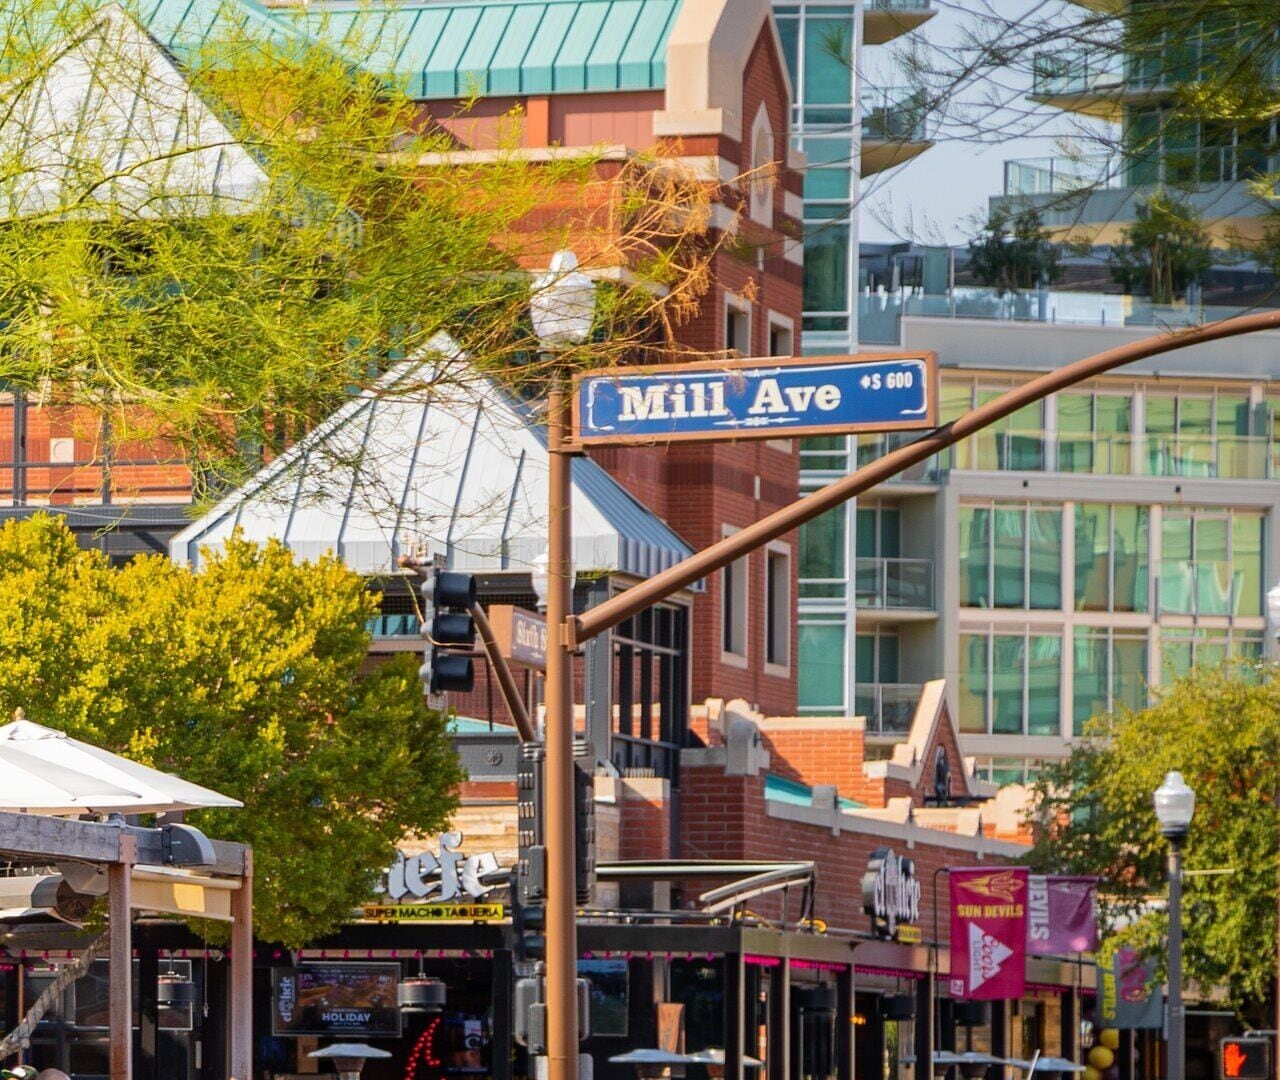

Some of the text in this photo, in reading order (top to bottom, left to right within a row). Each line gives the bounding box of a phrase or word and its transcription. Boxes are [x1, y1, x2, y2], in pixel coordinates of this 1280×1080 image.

[617, 381, 728, 421] Mill
[747, 377, 842, 415] Ave
[886, 371, 914, 390] 600
[517, 620, 539, 650] Sixth
[365, 906, 500, 918] SUPER MACHO TAQUERIA
[957, 904, 1024, 918] SUN DEVILS
[322, 1012, 372, 1022] HOLIDAY
